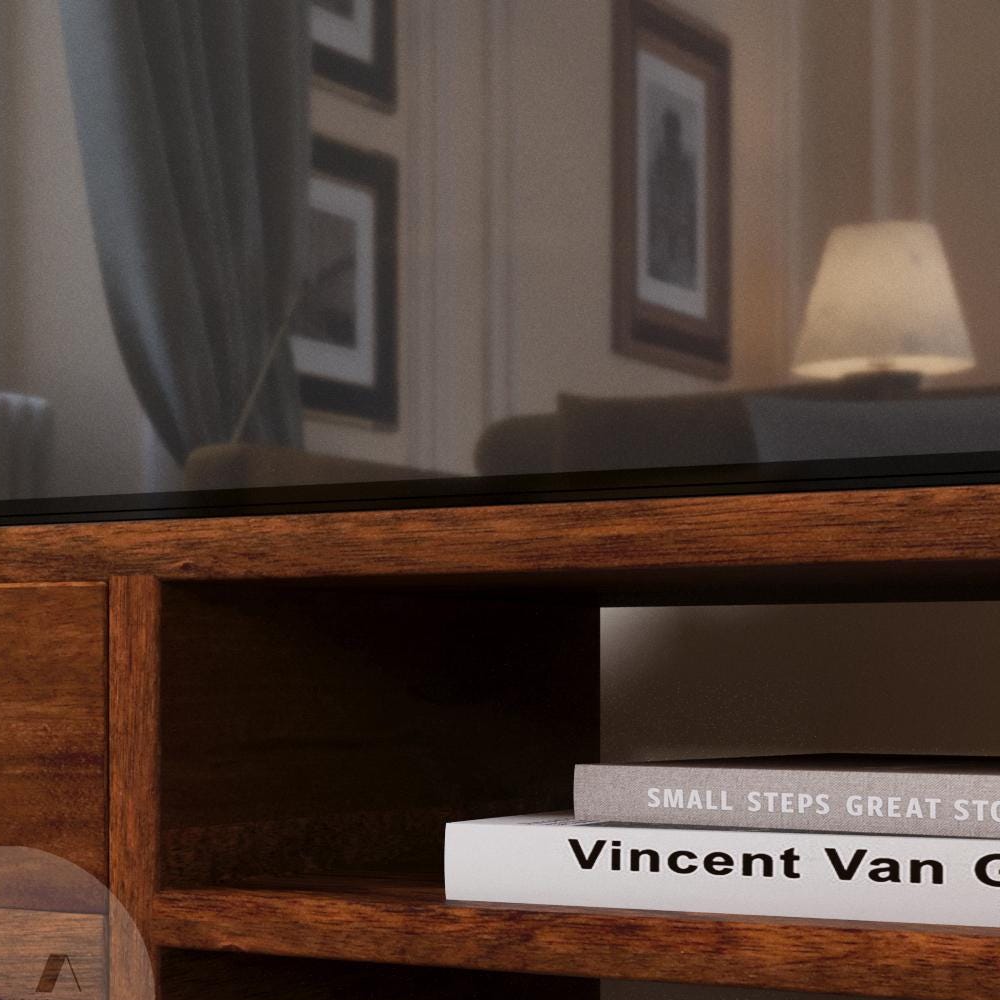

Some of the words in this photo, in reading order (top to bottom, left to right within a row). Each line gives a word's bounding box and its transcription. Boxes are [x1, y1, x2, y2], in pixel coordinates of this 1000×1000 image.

[647, 787, 733, 811] SMALL
[747, 791, 830, 815] STEPS
[846, 794, 942, 819] GREAT
[567, 838, 801, 879] Vincent
[824, 847, 944, 885] Van
